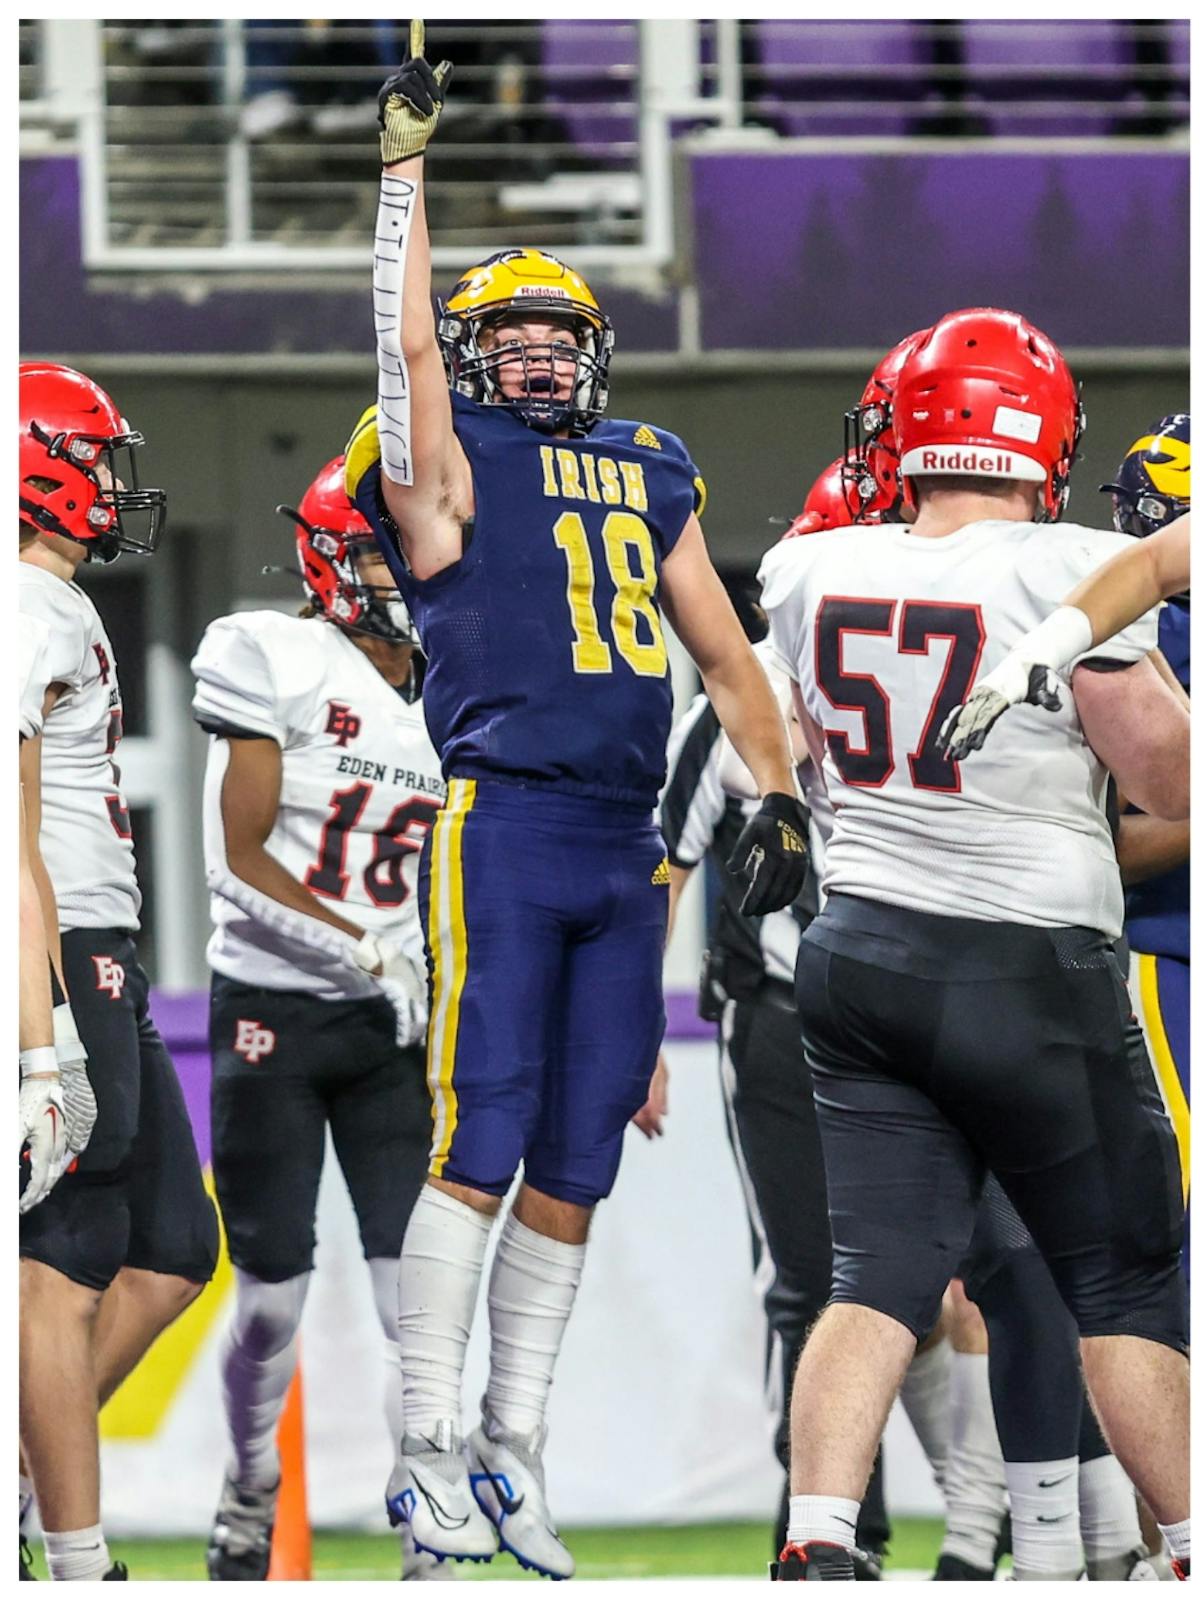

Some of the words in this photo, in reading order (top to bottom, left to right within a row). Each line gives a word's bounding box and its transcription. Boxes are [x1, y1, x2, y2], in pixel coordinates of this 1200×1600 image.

[520, 286, 565, 299] Riddell
[539, 445, 648, 513] IRISH
[922, 451, 1012, 473] Riddell
[552, 511, 668, 678] 18
[814, 595, 987, 793] 57
[336, 756, 388, 783] EDEN
